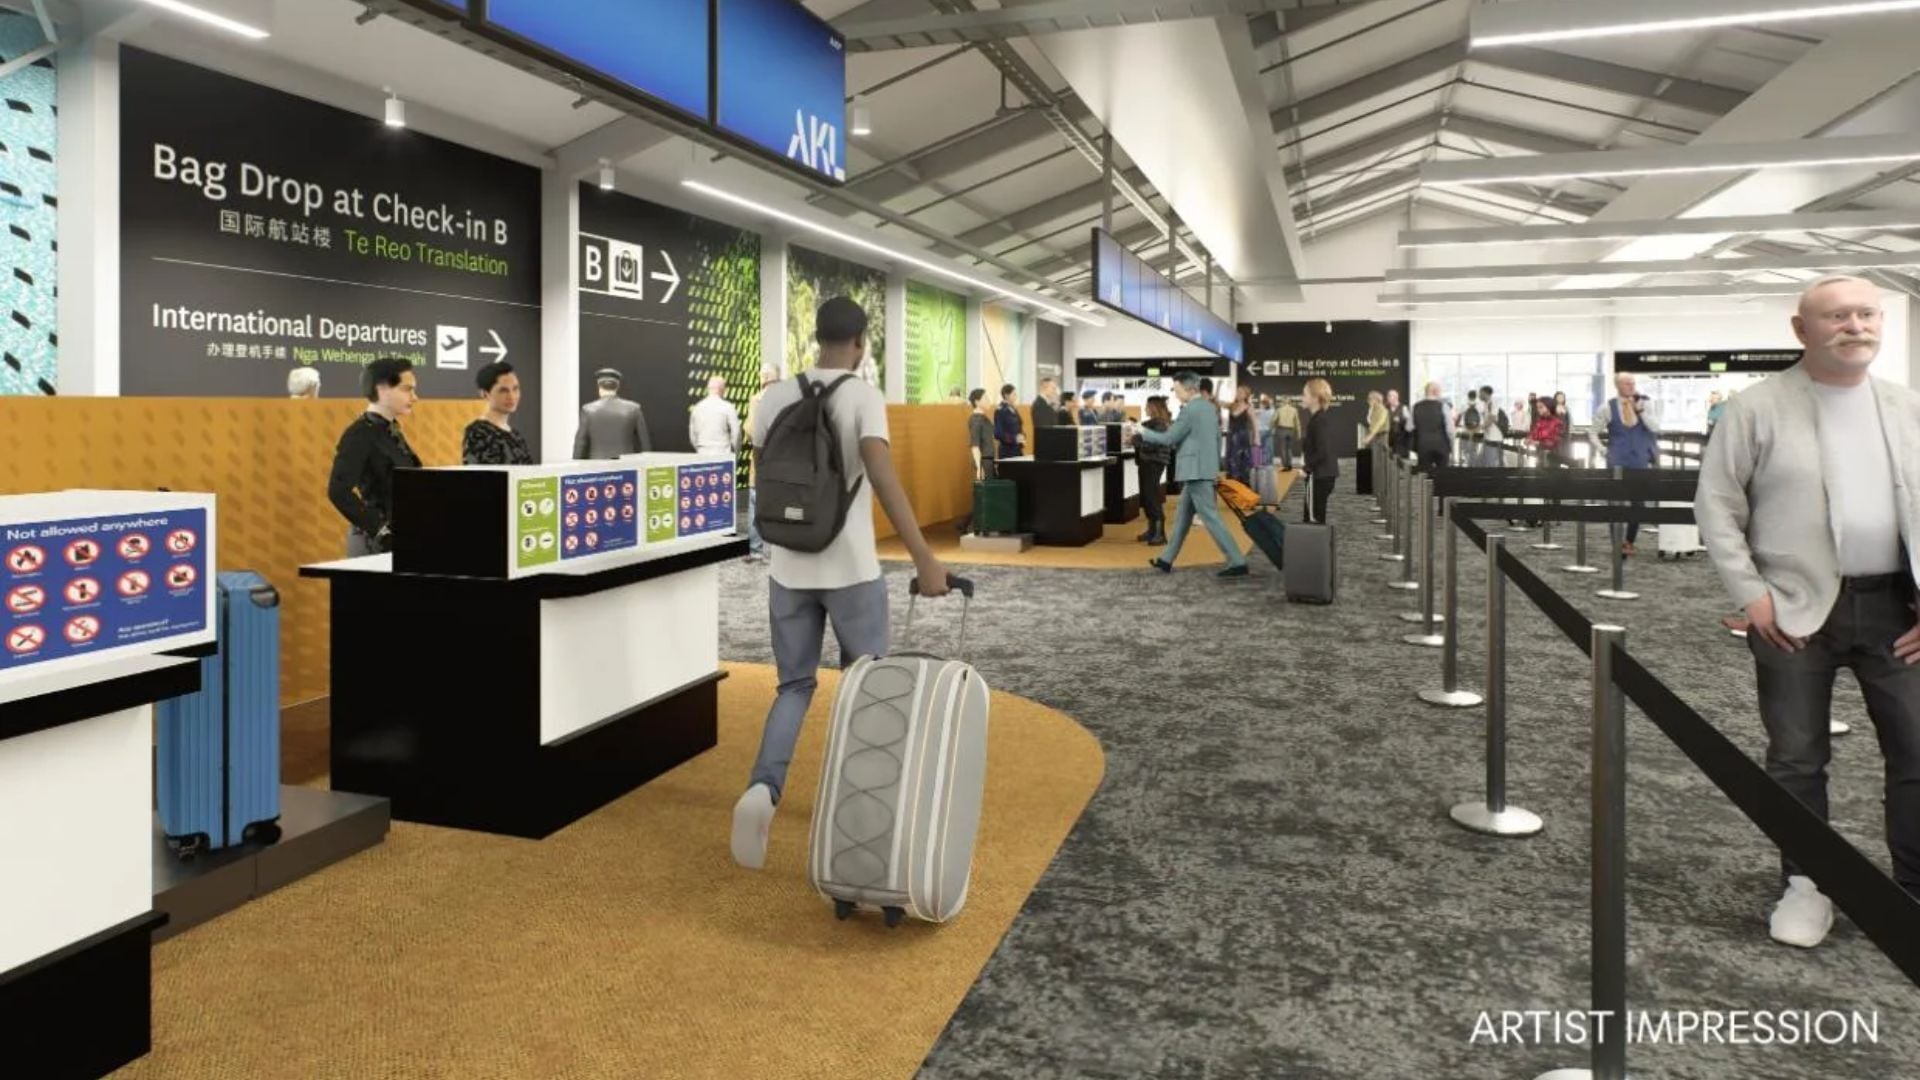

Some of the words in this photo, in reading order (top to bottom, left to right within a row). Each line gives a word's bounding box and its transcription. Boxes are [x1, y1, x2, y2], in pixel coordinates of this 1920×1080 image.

[787, 109, 845, 182] AKL
[154, 143, 227, 200] Bag
[240, 162, 323, 216] Drop
[333, 188, 365, 218] at
[372, 192, 487, 241] Check-in
[493, 219, 508, 245] B
[220, 209, 332, 249] 国际航站楼
[344, 229, 369, 254] Te
[375, 235, 412, 261] Reo
[415, 242, 508, 276] Translation
[585, 245, 602, 281] B
[153, 303, 313, 338] International
[319, 317, 428, 346] Departures
[293, 347, 319, 364] Nga
[321, 348, 376, 366] Wehenga
[1315, 359, 1338, 370] Drop
[7, 528, 36, 541] Not
[40, 522, 99, 538] allowed
[101, 516, 169, 532] anywhere
